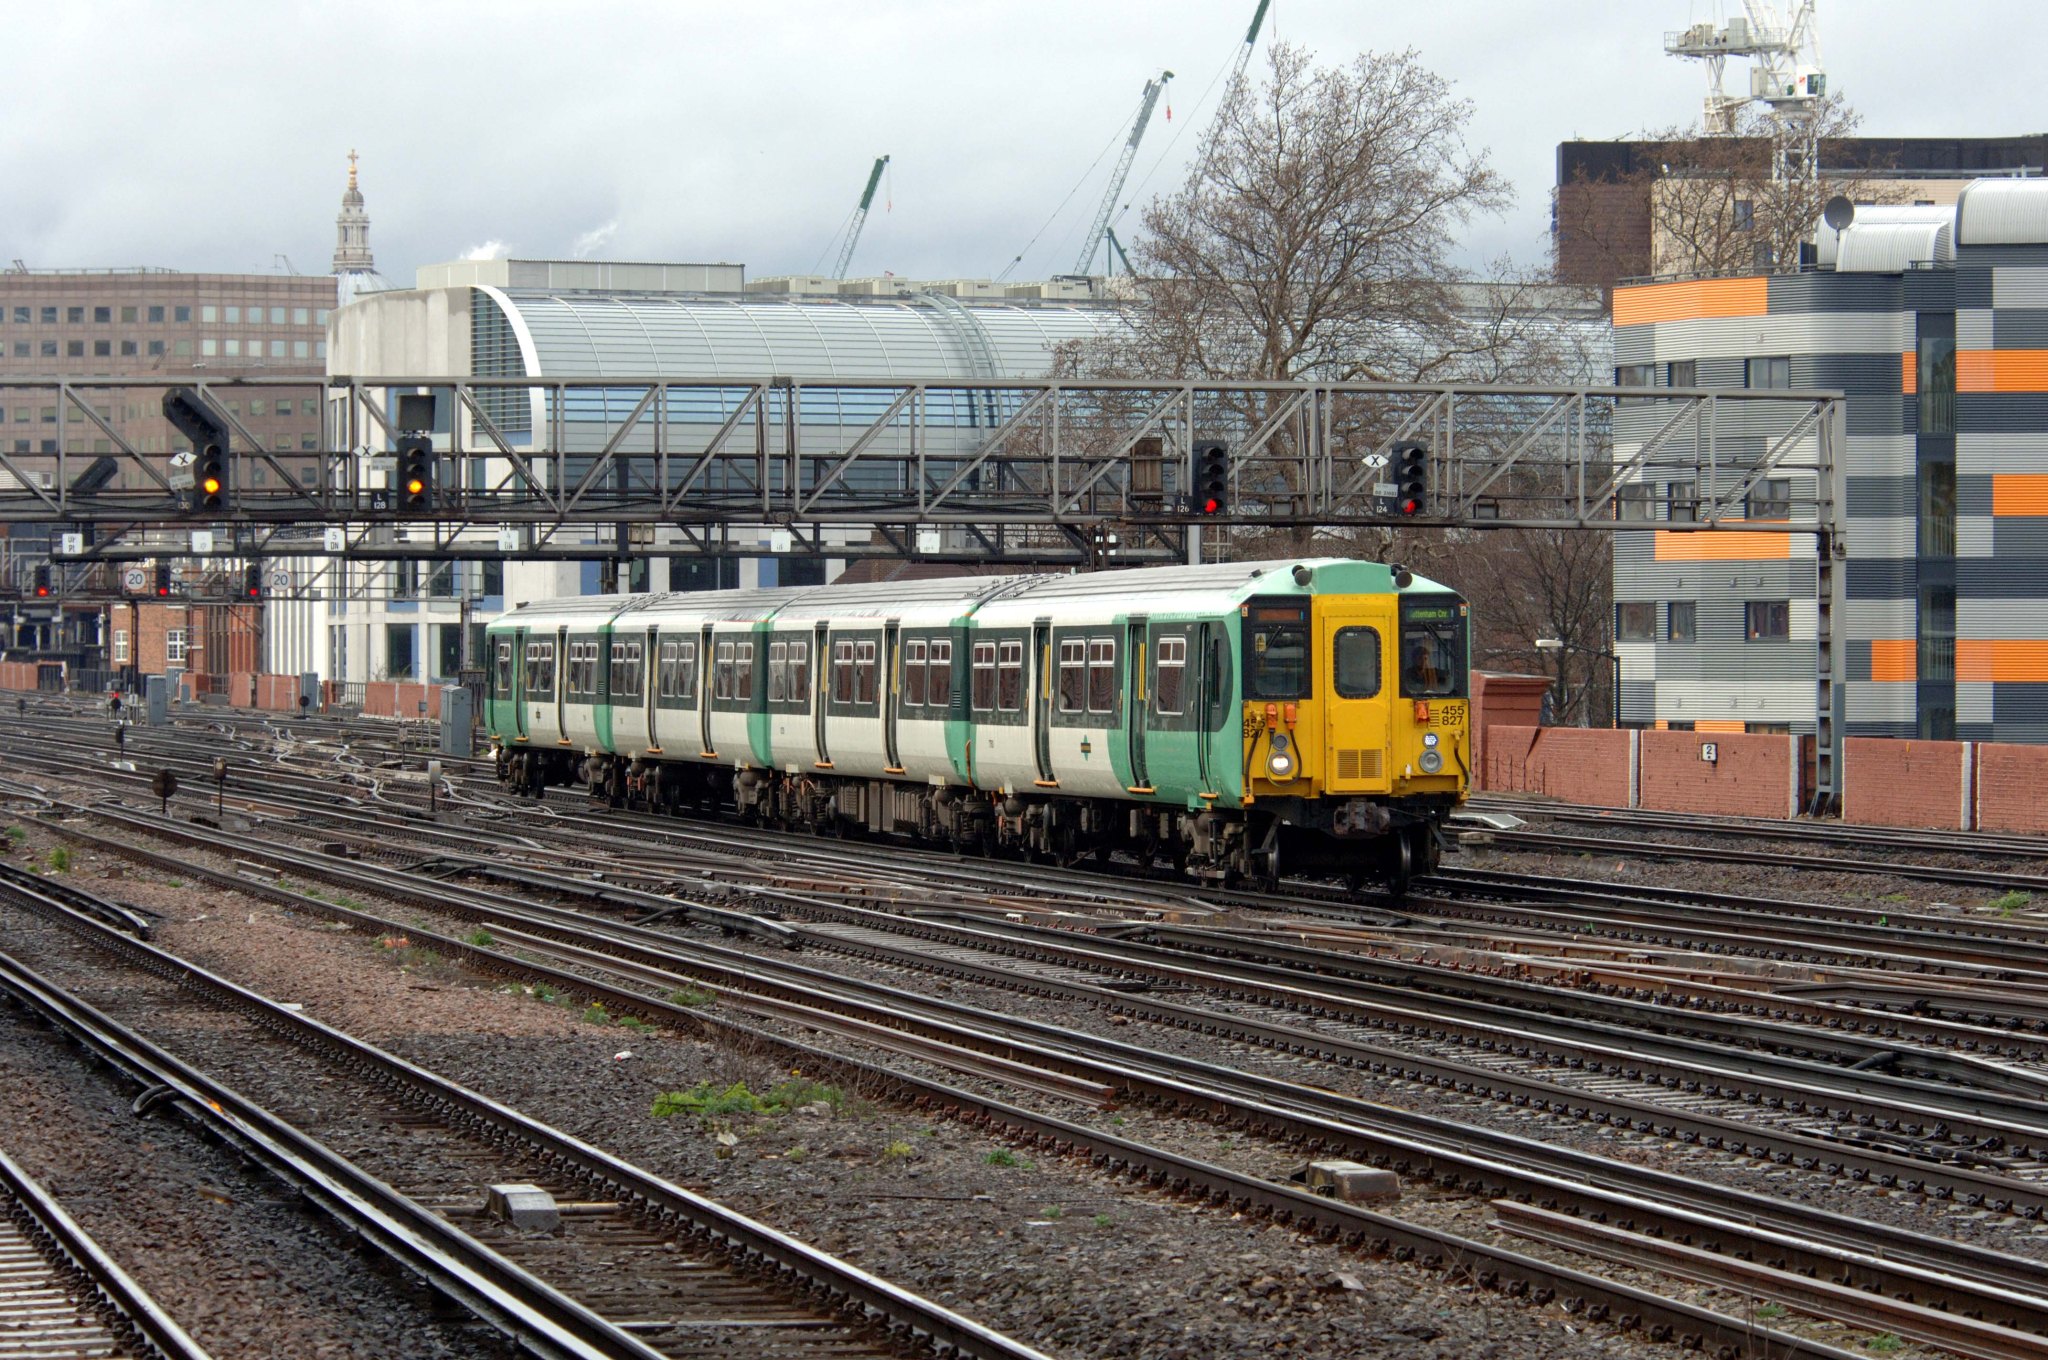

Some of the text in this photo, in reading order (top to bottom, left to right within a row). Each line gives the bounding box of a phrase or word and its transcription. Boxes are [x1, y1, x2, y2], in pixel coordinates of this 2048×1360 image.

[376, 493, 382, 501] L
[373, 501, 386, 510] 128
[1177, 505, 1190, 513] 126
[1376, 505, 1388, 513] 124
[128, 573, 143, 585] 20
[273, 574, 288, 586] 20
[1441, 705, 1465, 716] 455
[1441, 715, 1463, 726] 827
